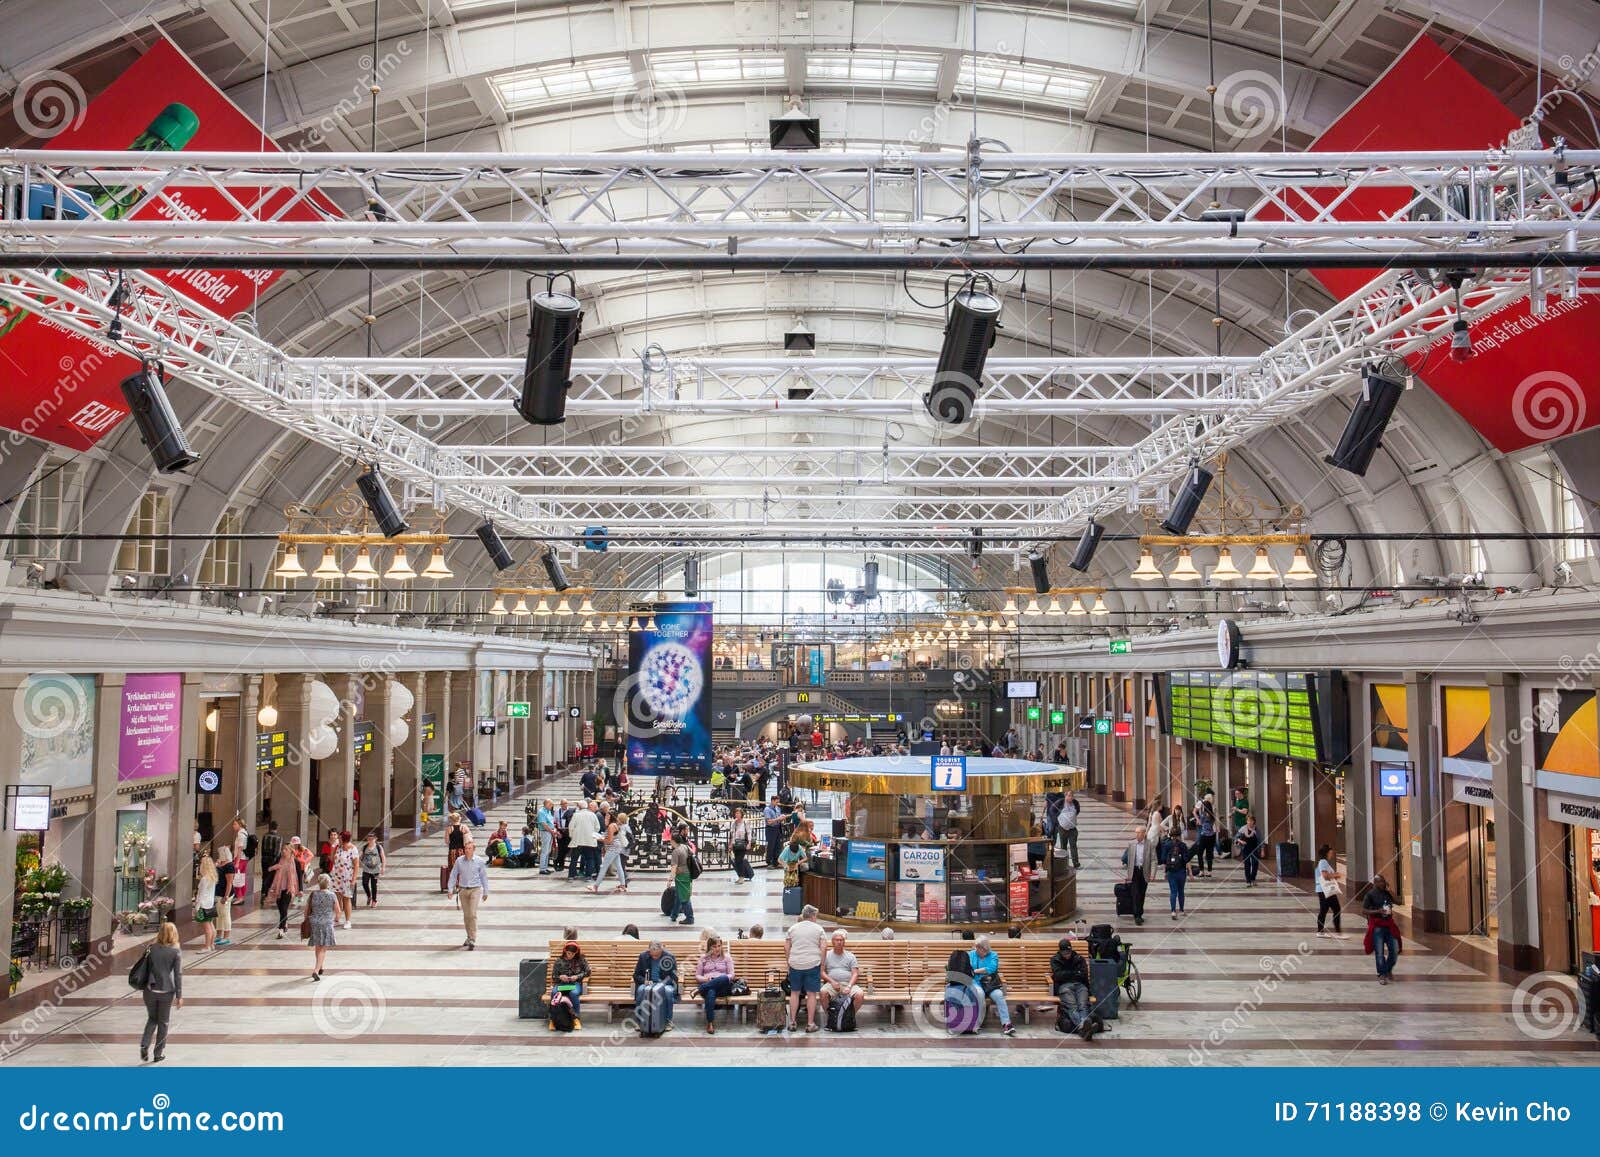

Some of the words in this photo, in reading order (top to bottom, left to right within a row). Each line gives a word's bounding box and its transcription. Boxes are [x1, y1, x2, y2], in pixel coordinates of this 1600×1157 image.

[1518, 314, 1540, 330] du
[68, 400, 125, 433] FELIX
[660, 623, 680, 631] COME
[654, 630, 689, 638] TOGETHER
[903, 851, 940, 861] CAR2GO
